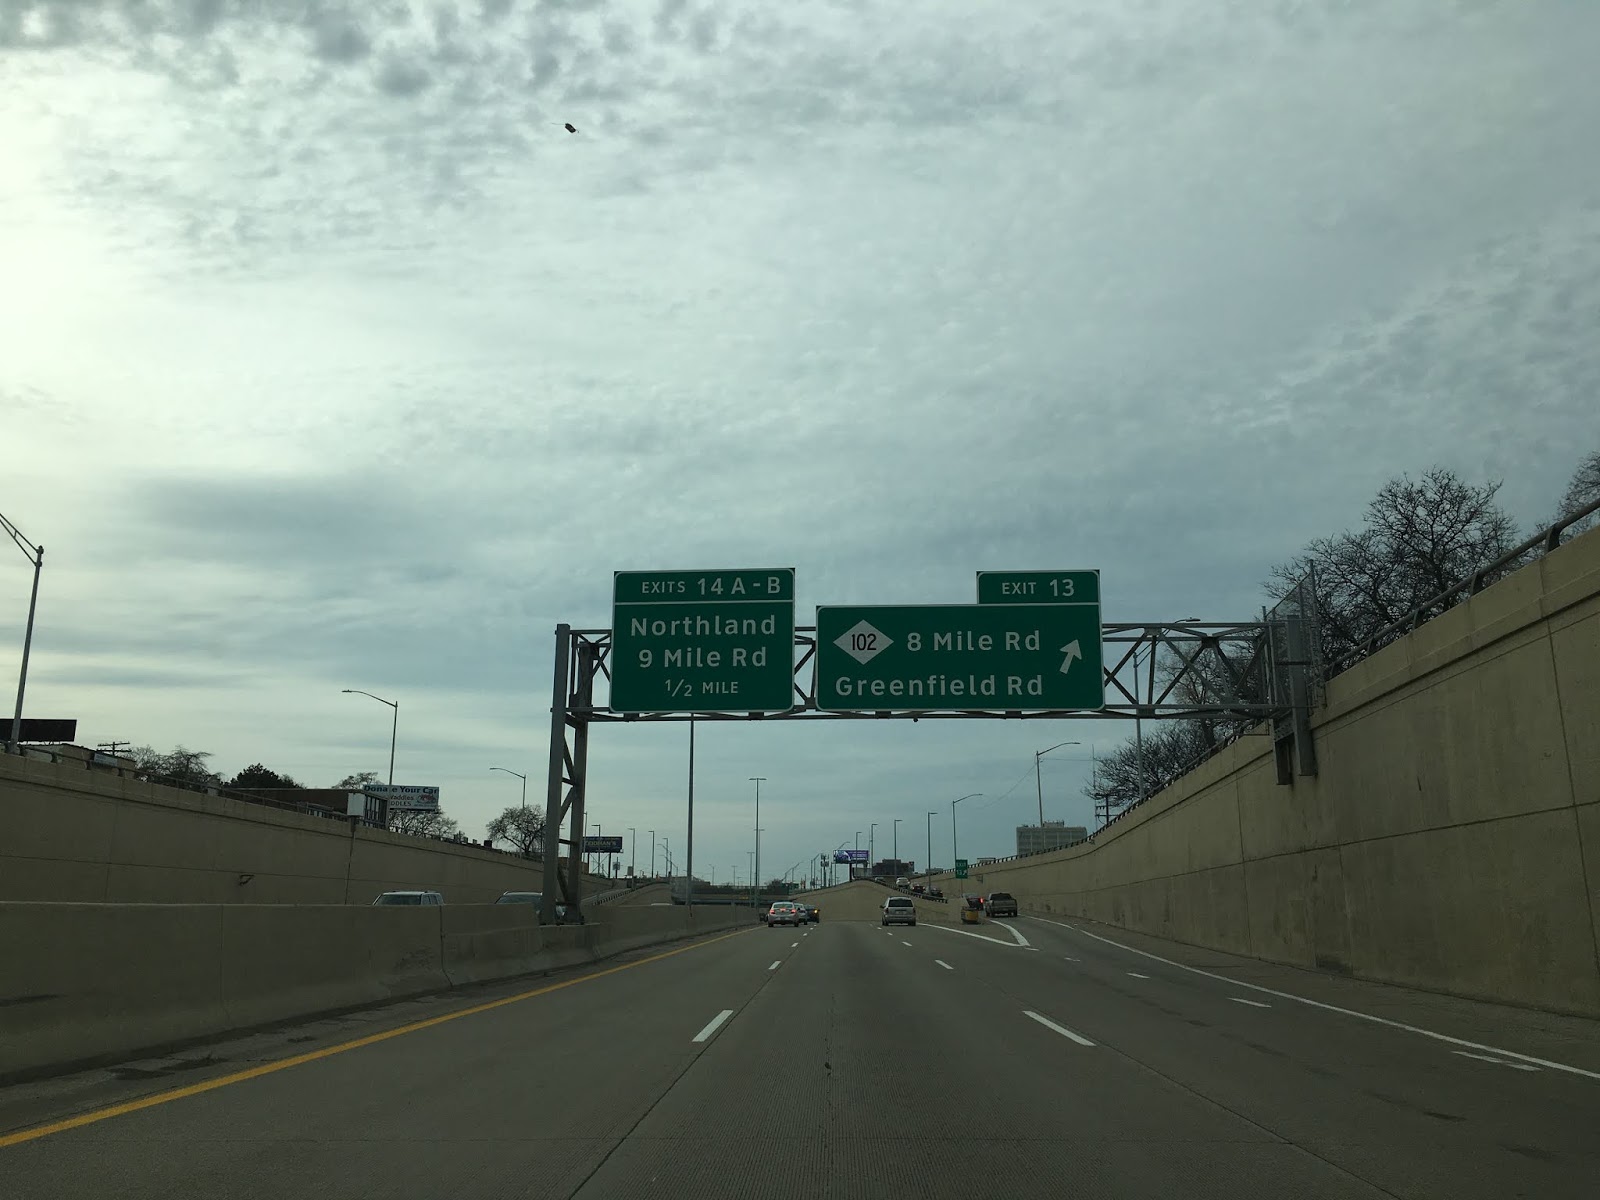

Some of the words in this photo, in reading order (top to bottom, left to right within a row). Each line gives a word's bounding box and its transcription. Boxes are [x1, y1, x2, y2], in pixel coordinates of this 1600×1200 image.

[641, 581, 686, 594] EXITS
[697, 577, 724, 595] 14
[1001, 582, 1037, 595] EXIT
[1048, 578, 1075, 597] 13
[631, 614, 776, 636] Northland
[850, 632, 877, 651] 102
[907, 631, 922, 652] 8
[933, 630, 994, 652] Mile
[1005, 630, 1040, 652] Rd
[638, 648, 653, 668] 9
[663, 647, 721, 668] Mile
[732, 646, 767, 668] Rd
[664, 679, 693, 698] 1/2
[702, 681, 739, 694] MILE
[835, 674, 996, 697] Greenfield
[1007, 674, 1043, 697] Rd
[364, 785, 398, 793] Donae
[422, 787, 438, 795] Car
